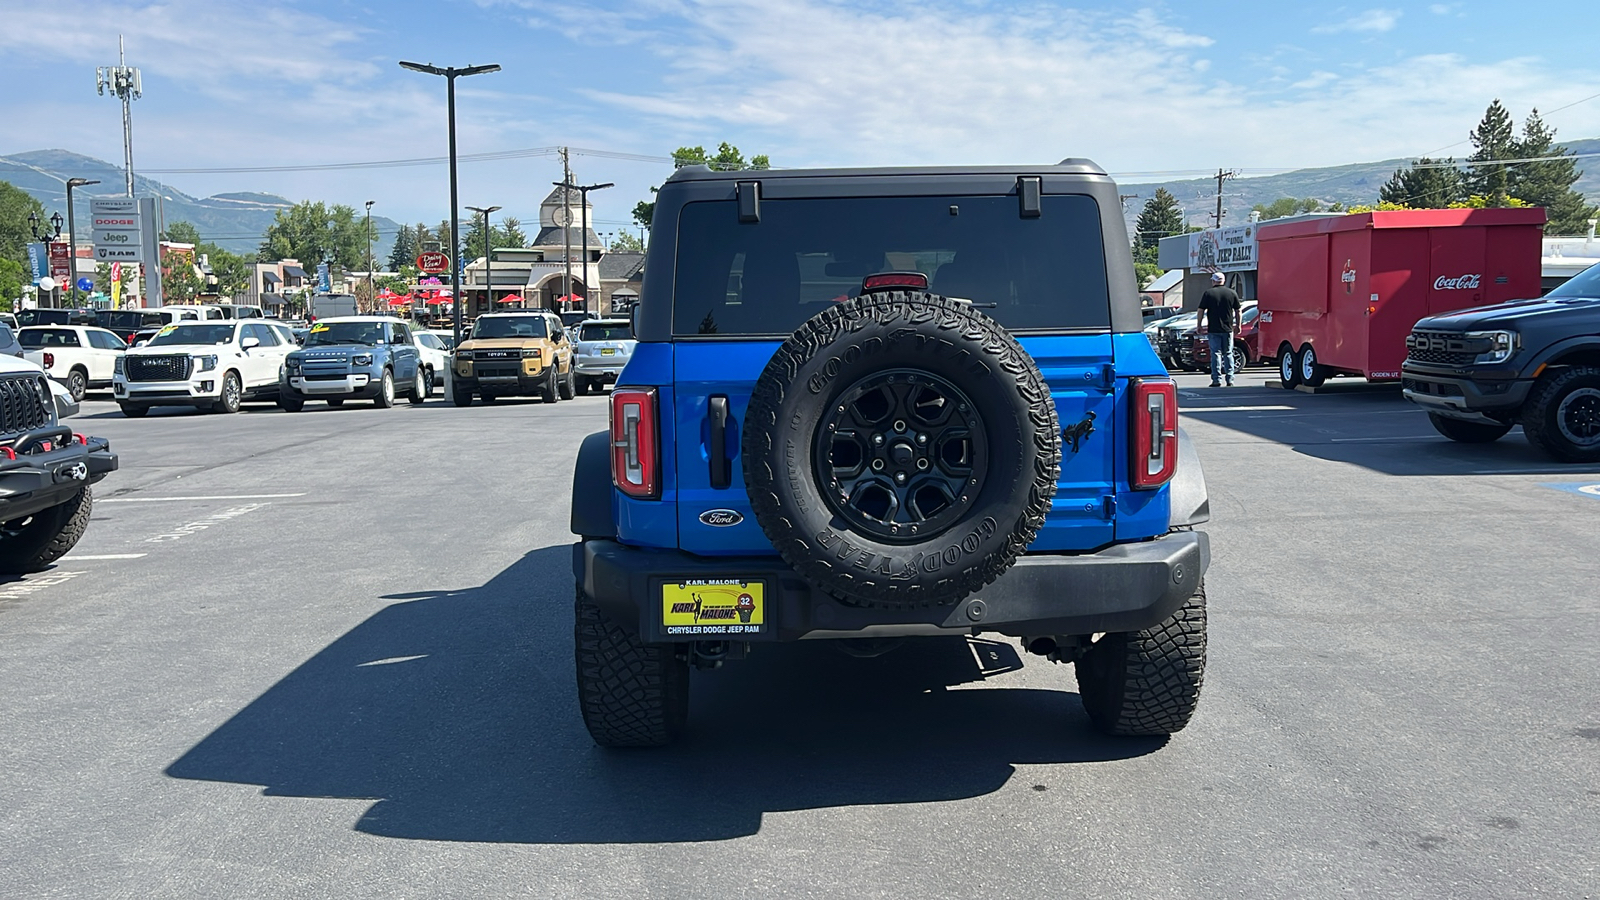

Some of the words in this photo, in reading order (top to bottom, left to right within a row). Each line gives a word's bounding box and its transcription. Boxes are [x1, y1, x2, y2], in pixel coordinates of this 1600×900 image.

[103, 232, 129, 243] Jeep
[421, 254, 442, 264] Dairy
[1217, 247, 1232, 263] JEEP
[1232, 245, 1252, 262] RALLY
[30, 247, 40, 278] UNIDAD
[1433, 273, 1482, 291] Coca-Cola
[1405, 336, 1464, 353] FORD
[708, 512, 734, 524] Ford
[815, 526, 892, 575] YEAR
[740, 598, 750, 606] 32
[671, 603, 695, 613] KARL
[699, 609, 737, 620] MALONE
[667, 626, 702, 634] CHRYSLER
